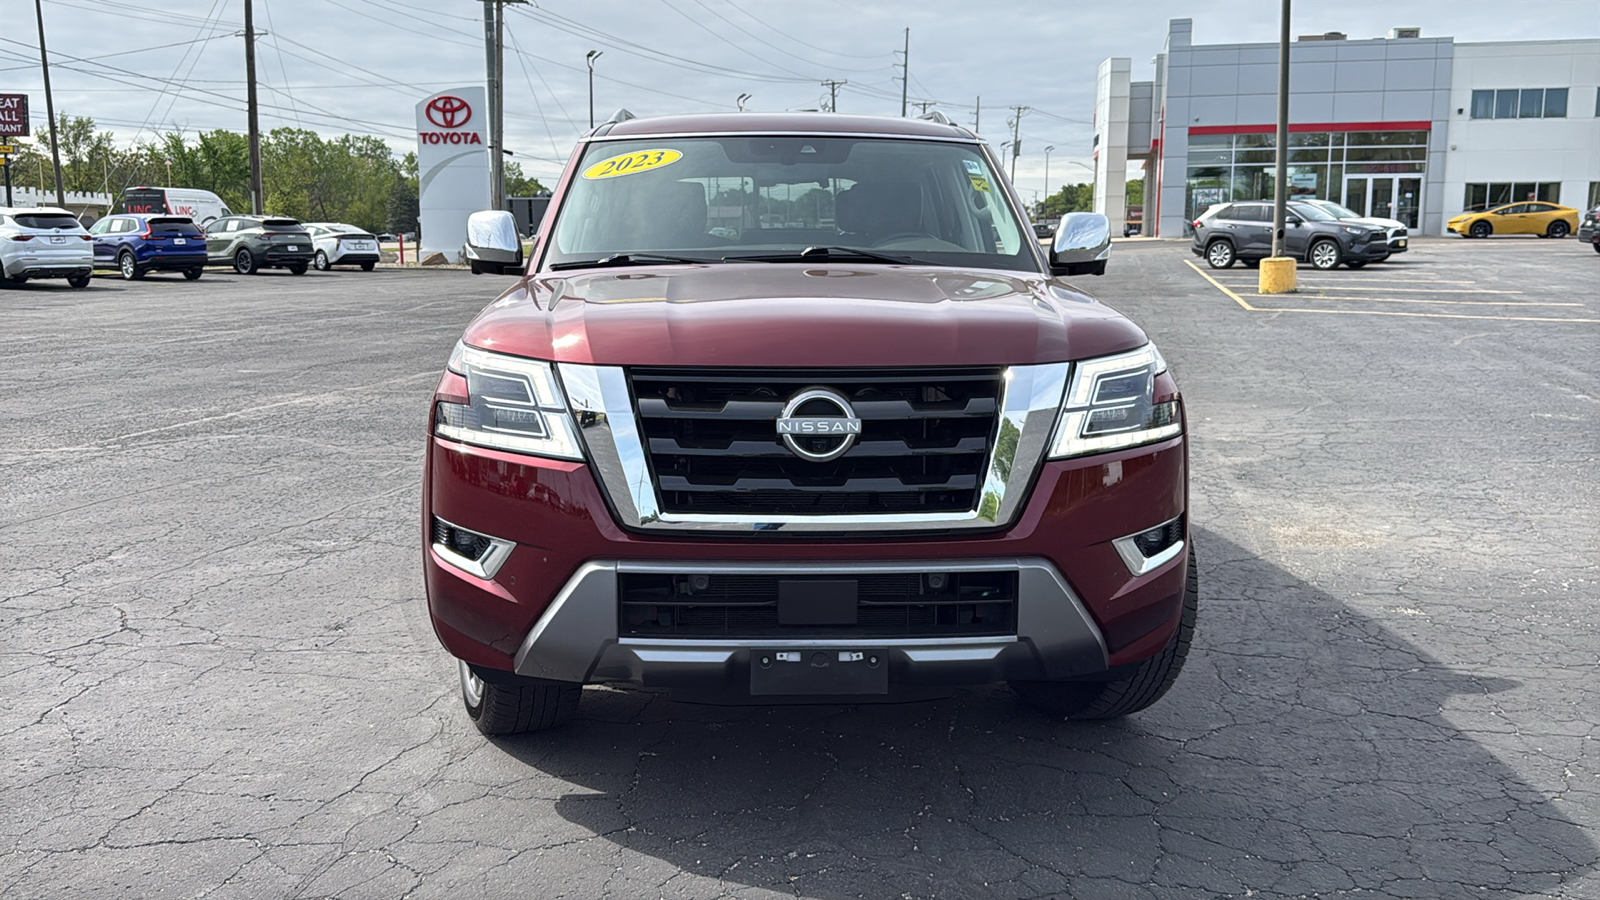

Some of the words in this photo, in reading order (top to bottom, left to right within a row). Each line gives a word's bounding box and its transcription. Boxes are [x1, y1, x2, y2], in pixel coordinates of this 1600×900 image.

[419, 132, 481, 144] TOYOTA
[598, 152, 665, 176] 2023
[779, 421, 859, 432] NISSAN
